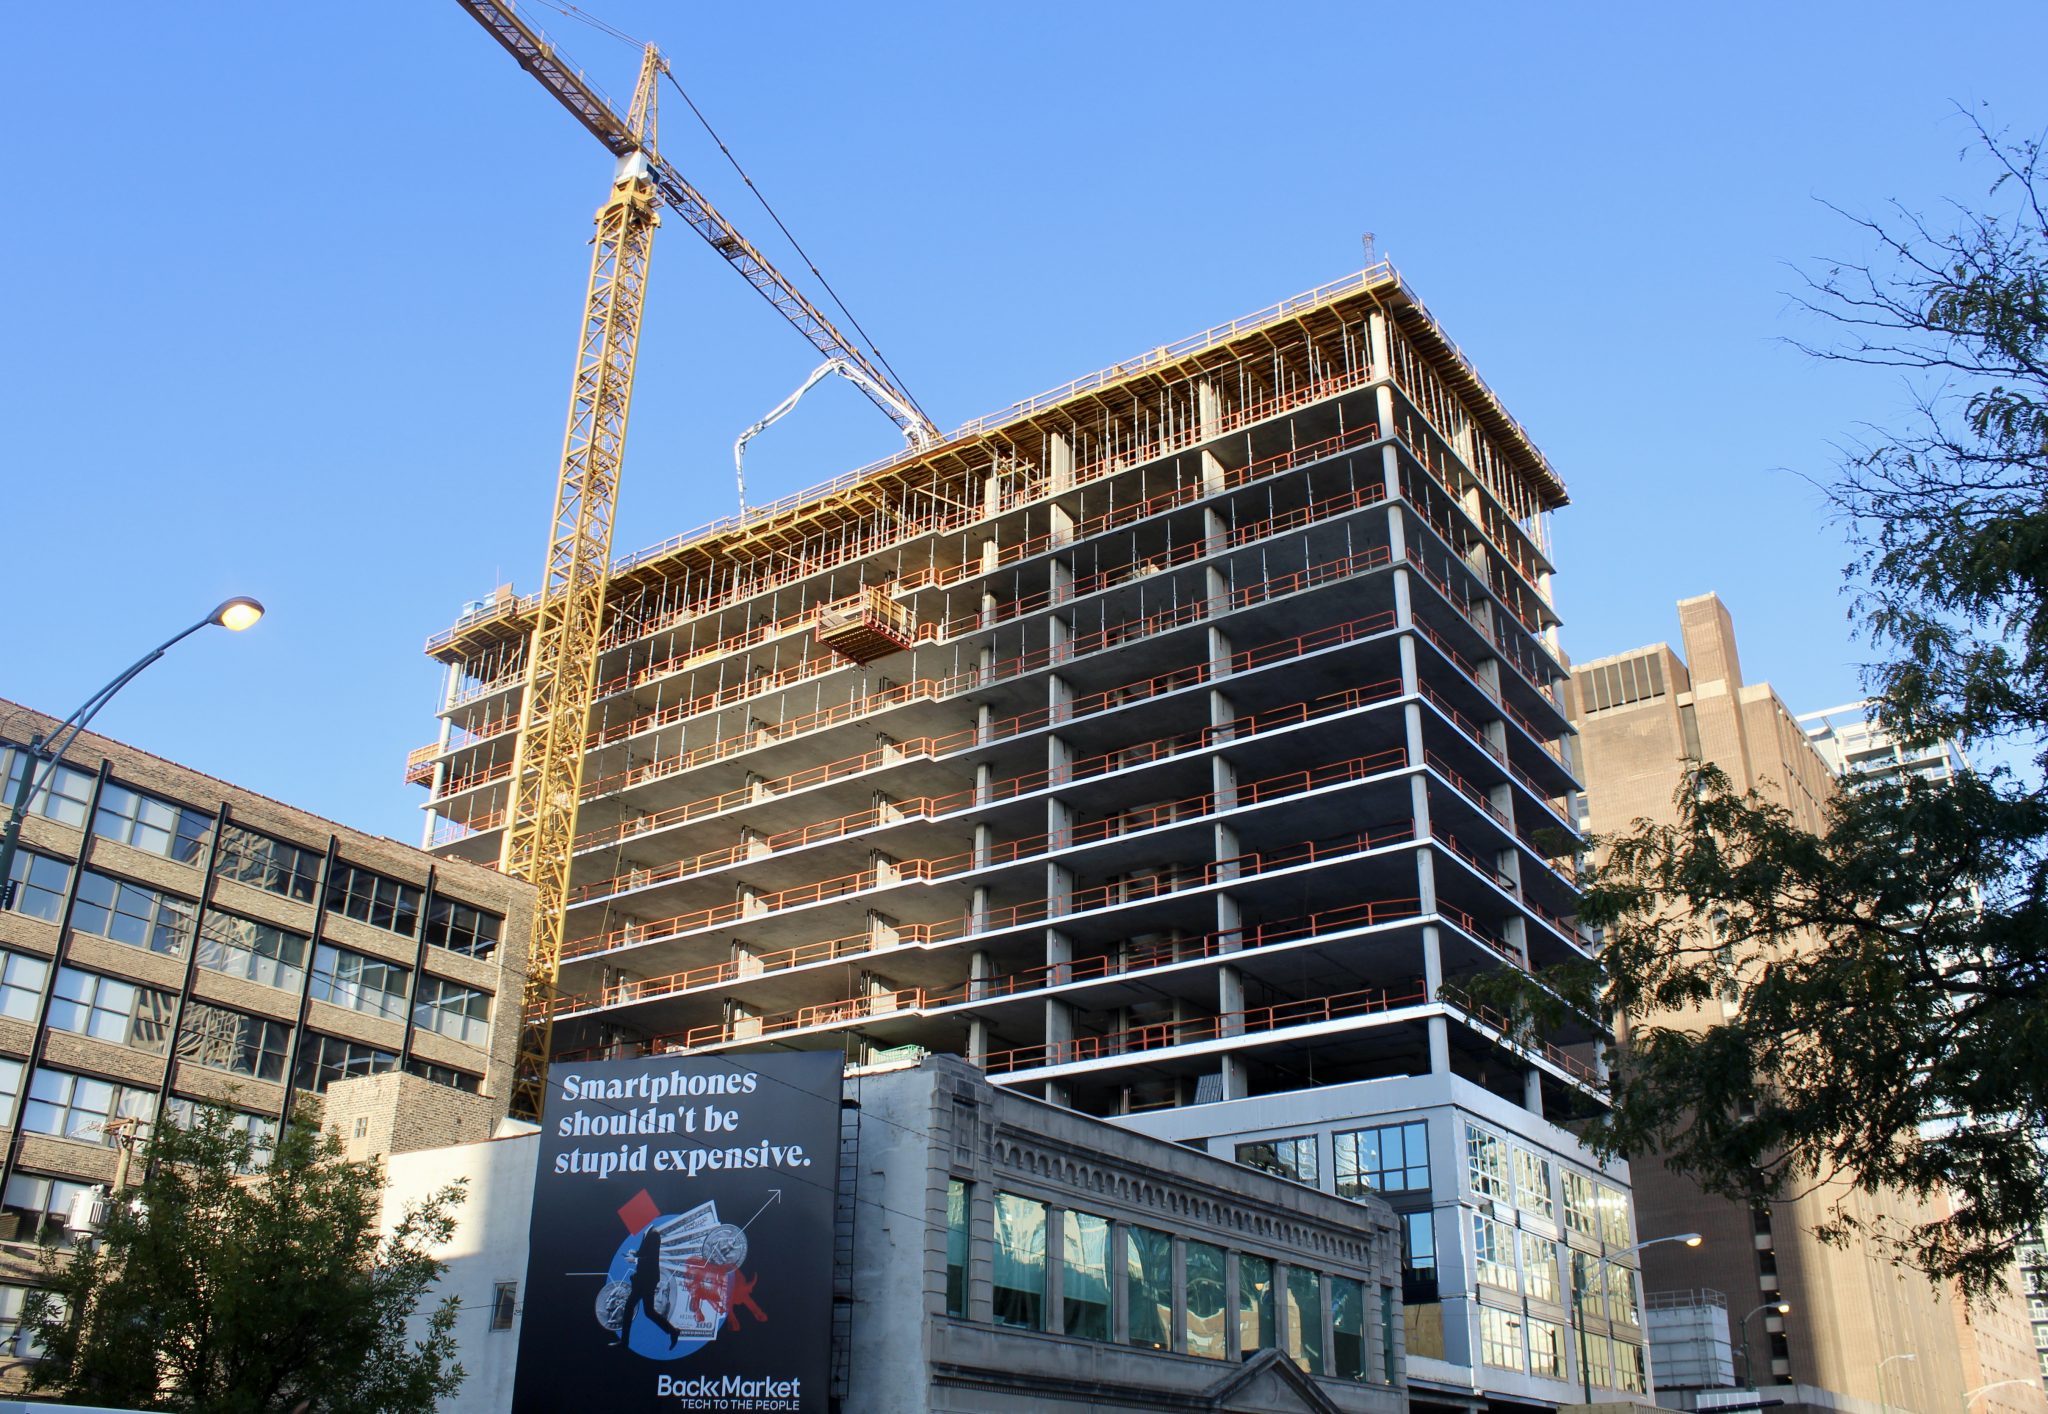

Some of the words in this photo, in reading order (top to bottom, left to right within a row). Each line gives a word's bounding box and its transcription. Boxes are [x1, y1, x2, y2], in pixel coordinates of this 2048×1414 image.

[561, 1069, 758, 1104] Smartphones
[558, 1106, 697, 1137] shouldn't
[704, 1105, 739, 1132] be
[554, 1144, 648, 1179] stupid
[653, 1139, 811, 1177] expensive.
[681, 1398, 711, 1410] TECH
[713, 1399, 729, 1410] TO
[730, 1399, 753, 1411] THE
[755, 1399, 800, 1411] PEOPLE
